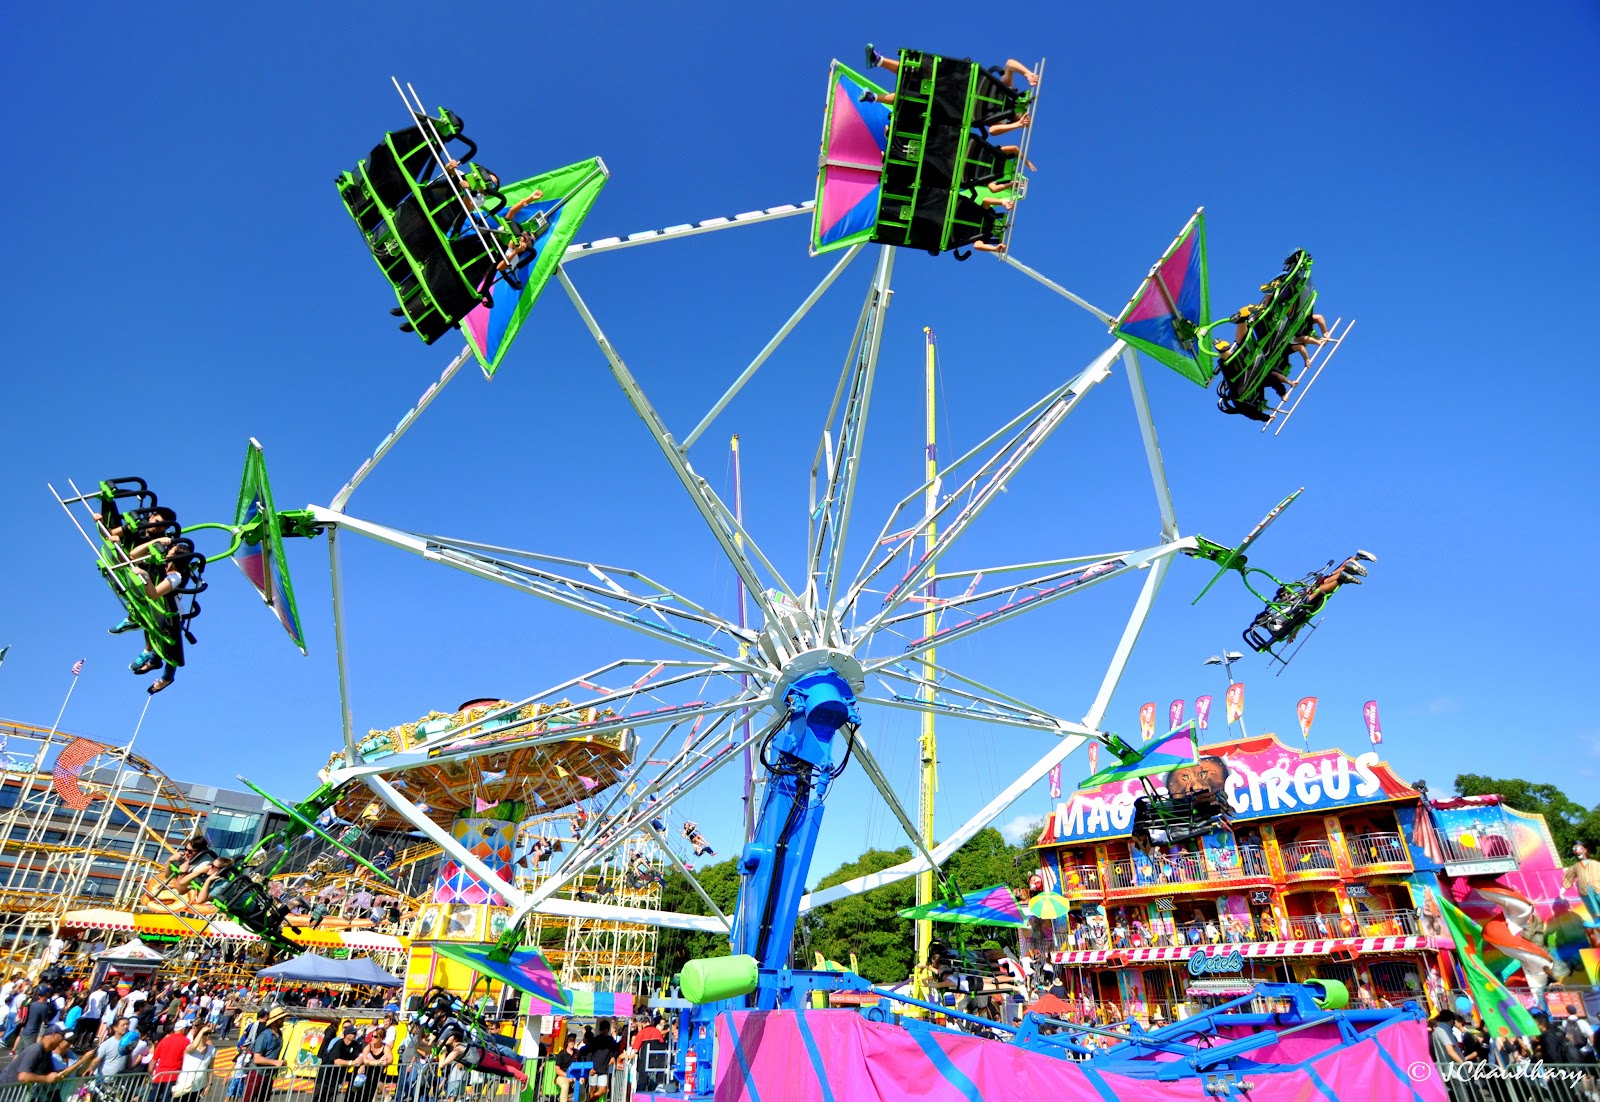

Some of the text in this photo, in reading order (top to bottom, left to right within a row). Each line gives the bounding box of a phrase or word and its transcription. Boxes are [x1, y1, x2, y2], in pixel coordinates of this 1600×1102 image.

[1054, 752, 1380, 837] MAG CIRCUS
[1346, 886, 1366, 894] CIRCUS
